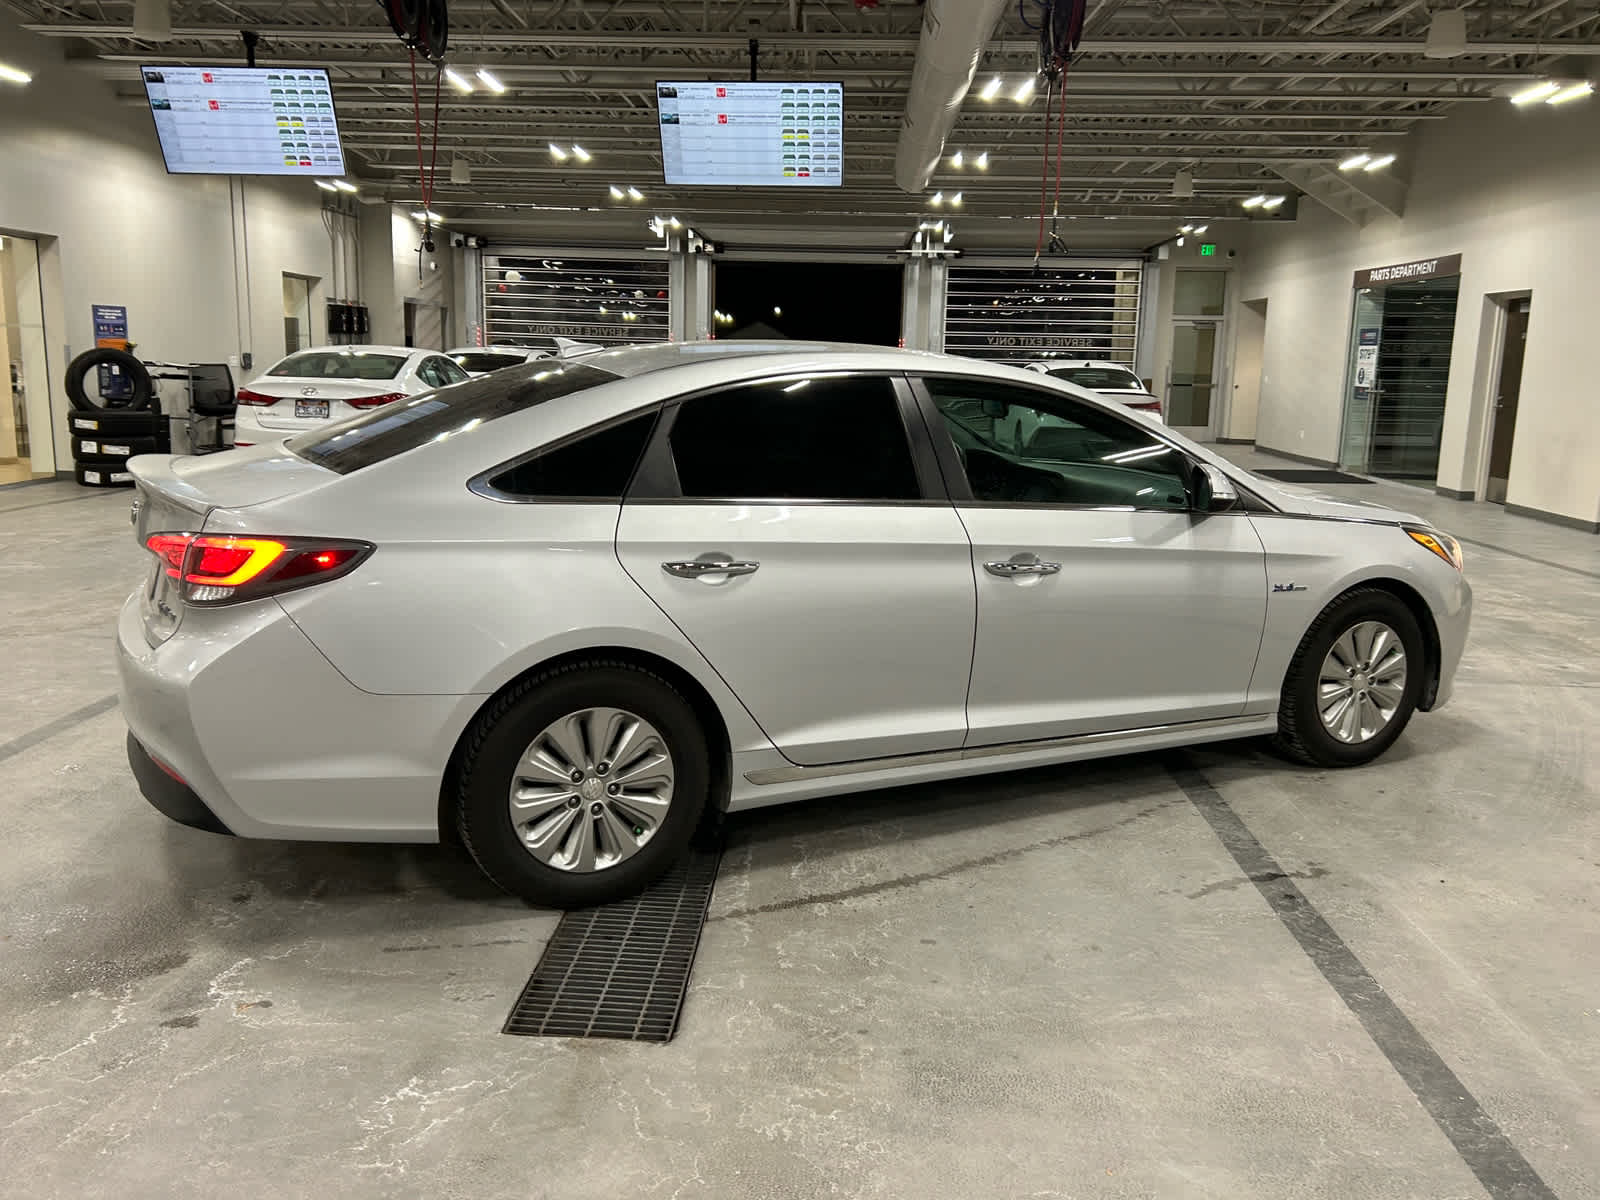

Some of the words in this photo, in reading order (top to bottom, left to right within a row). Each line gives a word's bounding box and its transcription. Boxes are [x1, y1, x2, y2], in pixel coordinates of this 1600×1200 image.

[1201, 244, 1216, 256] EXIT
[1369, 267, 1390, 282] PARTS
[1390, 260, 1438, 279] DEPARTMENT
